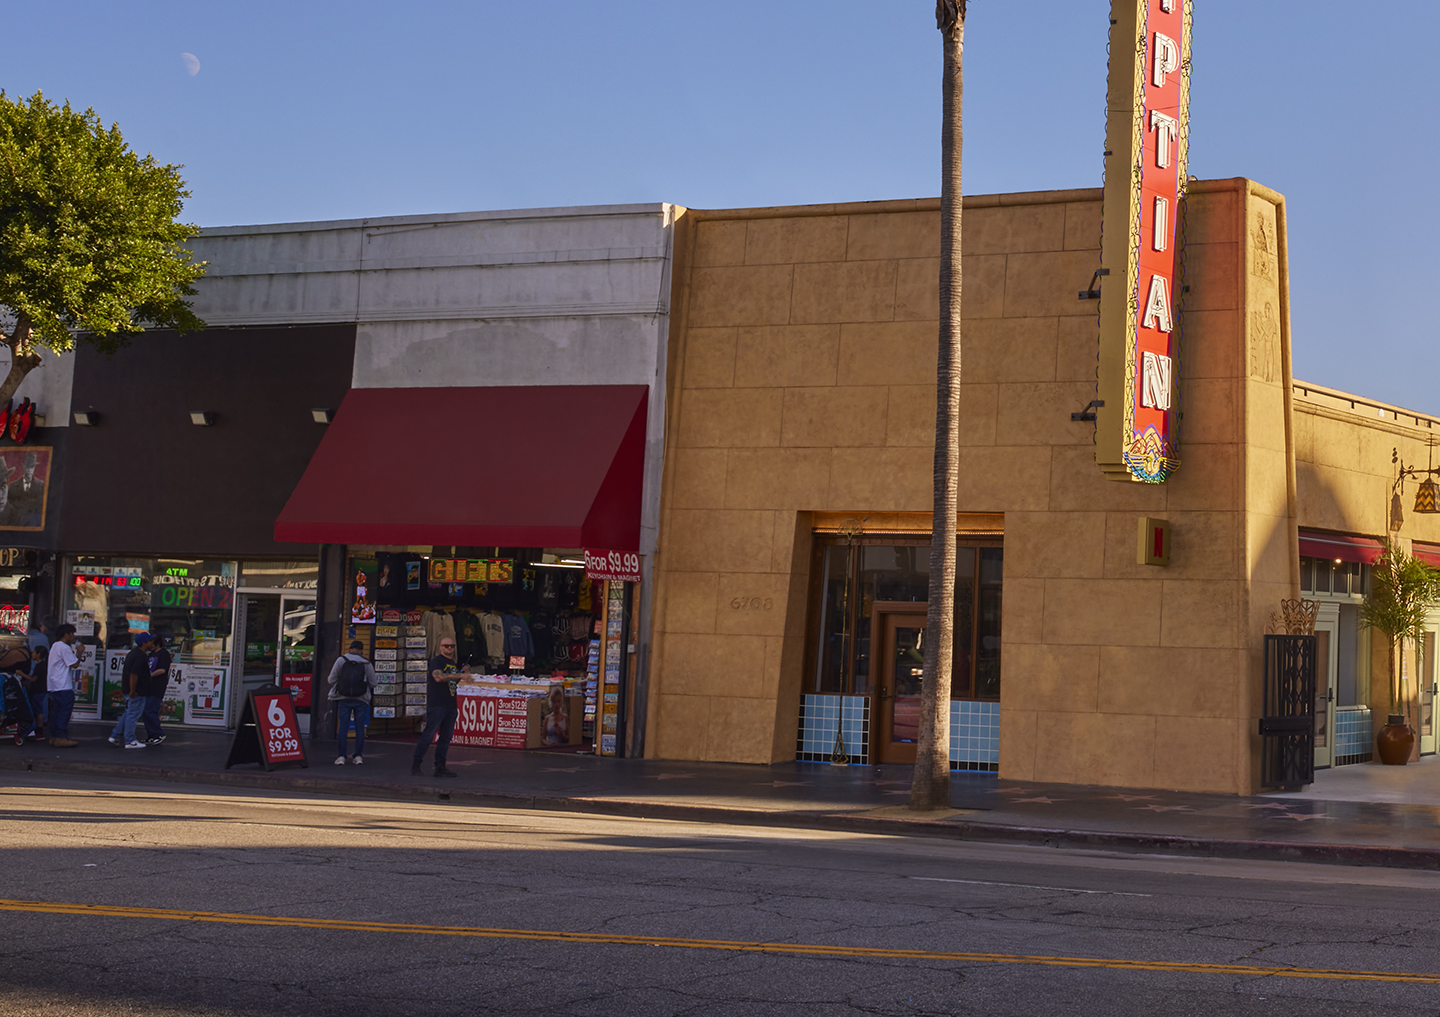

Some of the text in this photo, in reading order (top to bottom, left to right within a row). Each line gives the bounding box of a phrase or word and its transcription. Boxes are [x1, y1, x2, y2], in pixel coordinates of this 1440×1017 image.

[1153, 526, 1164, 558] N
[608, 550, 640, 574] $9.99
[166, 568, 188, 576] ATM
[432, 560, 513, 580] GIFTS
[587, 572, 612, 580] KEYCHAIN
[617, 574, 641, 582] MAGNET
[162, 586, 214, 608] OPEN
[730, 596, 773, 611] 6708
[511, 700, 528, 710] $12.99
[267, 698, 286, 727] 6
[461, 697, 495, 733] $9.99
[511, 718, 527, 728] $9.99
[269, 727, 292, 740] FOR
[268, 739, 299, 753] $9.99
[470, 736, 494, 746] MAGNET
